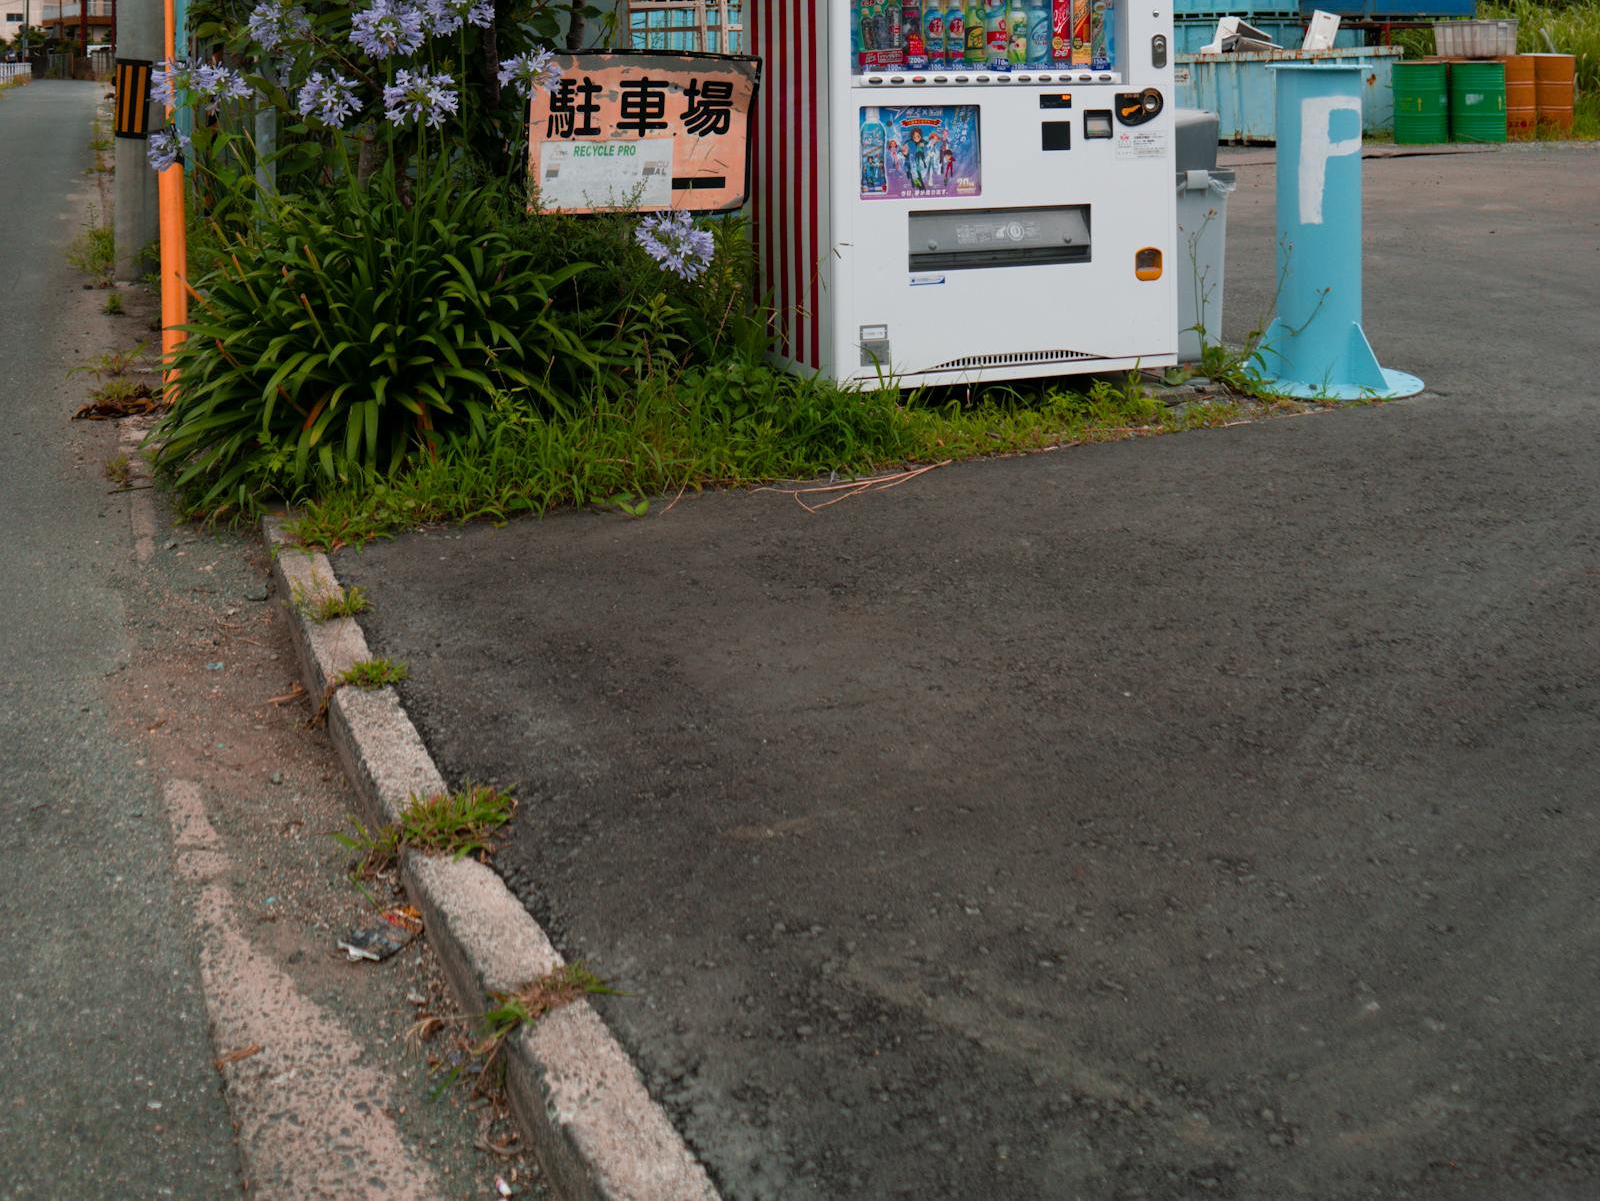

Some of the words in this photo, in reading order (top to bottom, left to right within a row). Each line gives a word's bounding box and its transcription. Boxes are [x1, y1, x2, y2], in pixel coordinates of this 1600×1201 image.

[547, 76, 734, 138] 駐車場
[573, 146, 615, 158] RECYCLE
[617, 145, 636, 156] PRO
[1299, 96, 1362, 224] P
